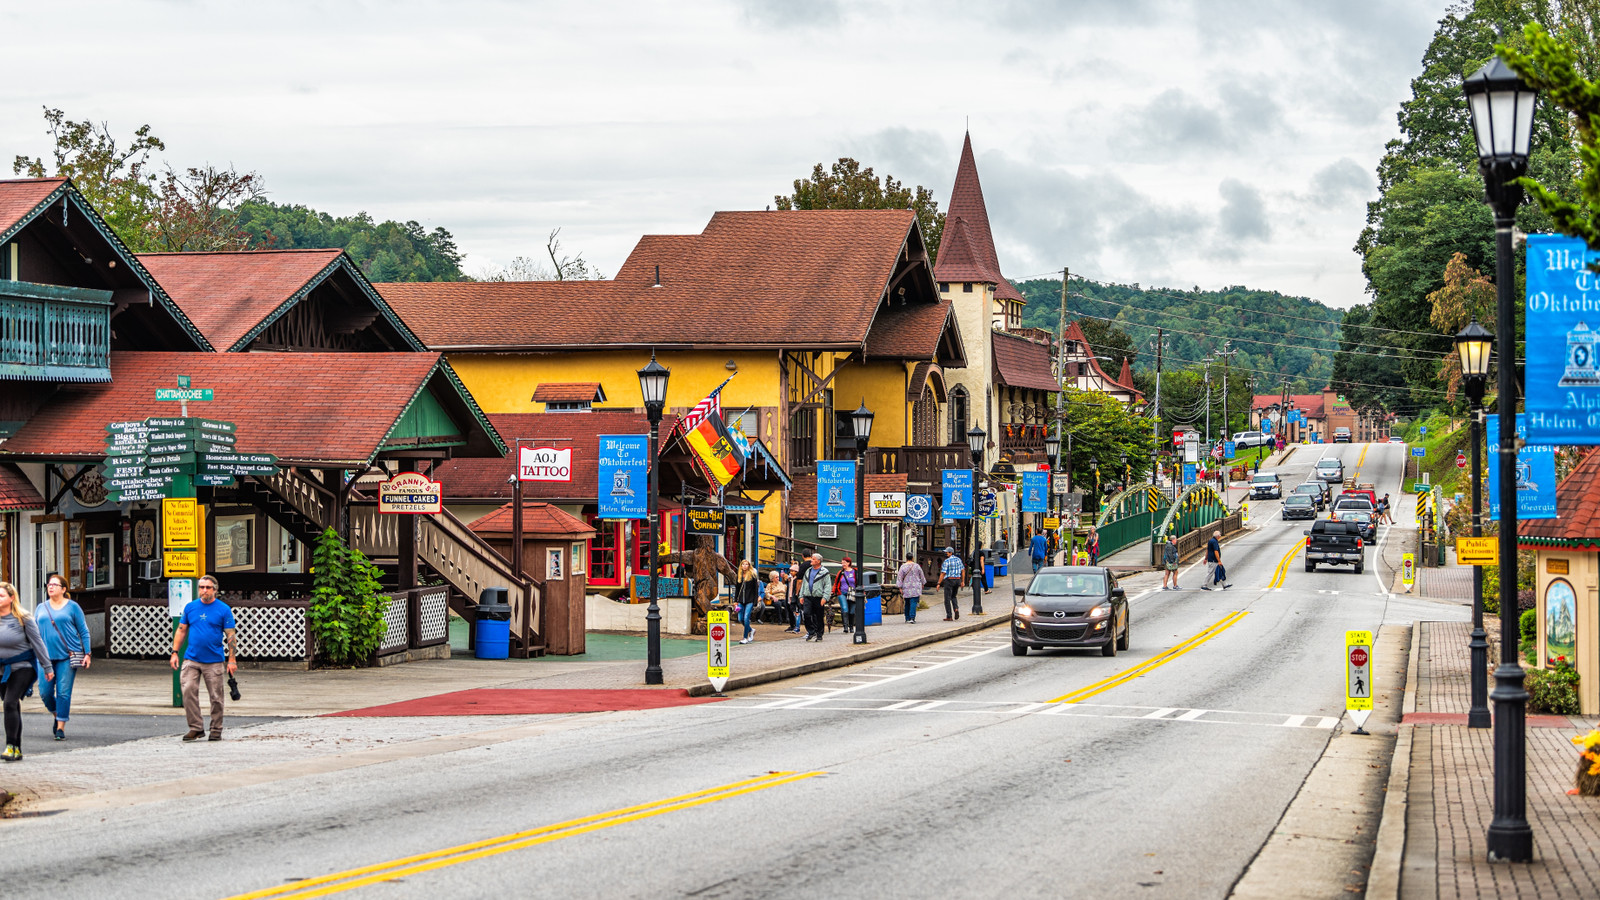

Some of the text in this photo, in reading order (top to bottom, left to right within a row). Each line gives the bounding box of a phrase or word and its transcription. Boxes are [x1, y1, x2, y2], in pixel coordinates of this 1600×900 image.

[156, 389, 202, 399] CHATTAHOOCHEE
[1563, 392, 1600, 412] Alpi
[1530, 412, 1582, 429] Helen,
[606, 440, 640, 451] Welcome
[533, 453, 558, 463] AOJ
[617, 450, 629, 458] To
[600, 457, 646, 467] Oktoberfest
[522, 466, 569, 476] TATTOO
[112, 478, 163, 486] Chattahoochee
[391, 478, 432, 492] GRANNY'S
[613, 497, 634, 505] Alpine
[1517, 494, 1538, 502] lpine
[874, 500, 901, 508] TEAM
[1521, 503, 1555, 513] Georgia
[600, 505, 646, 514] Helen, Georgia
[688, 510, 724, 521] HELEN HAT
[693, 519, 721, 530] COMPANY
